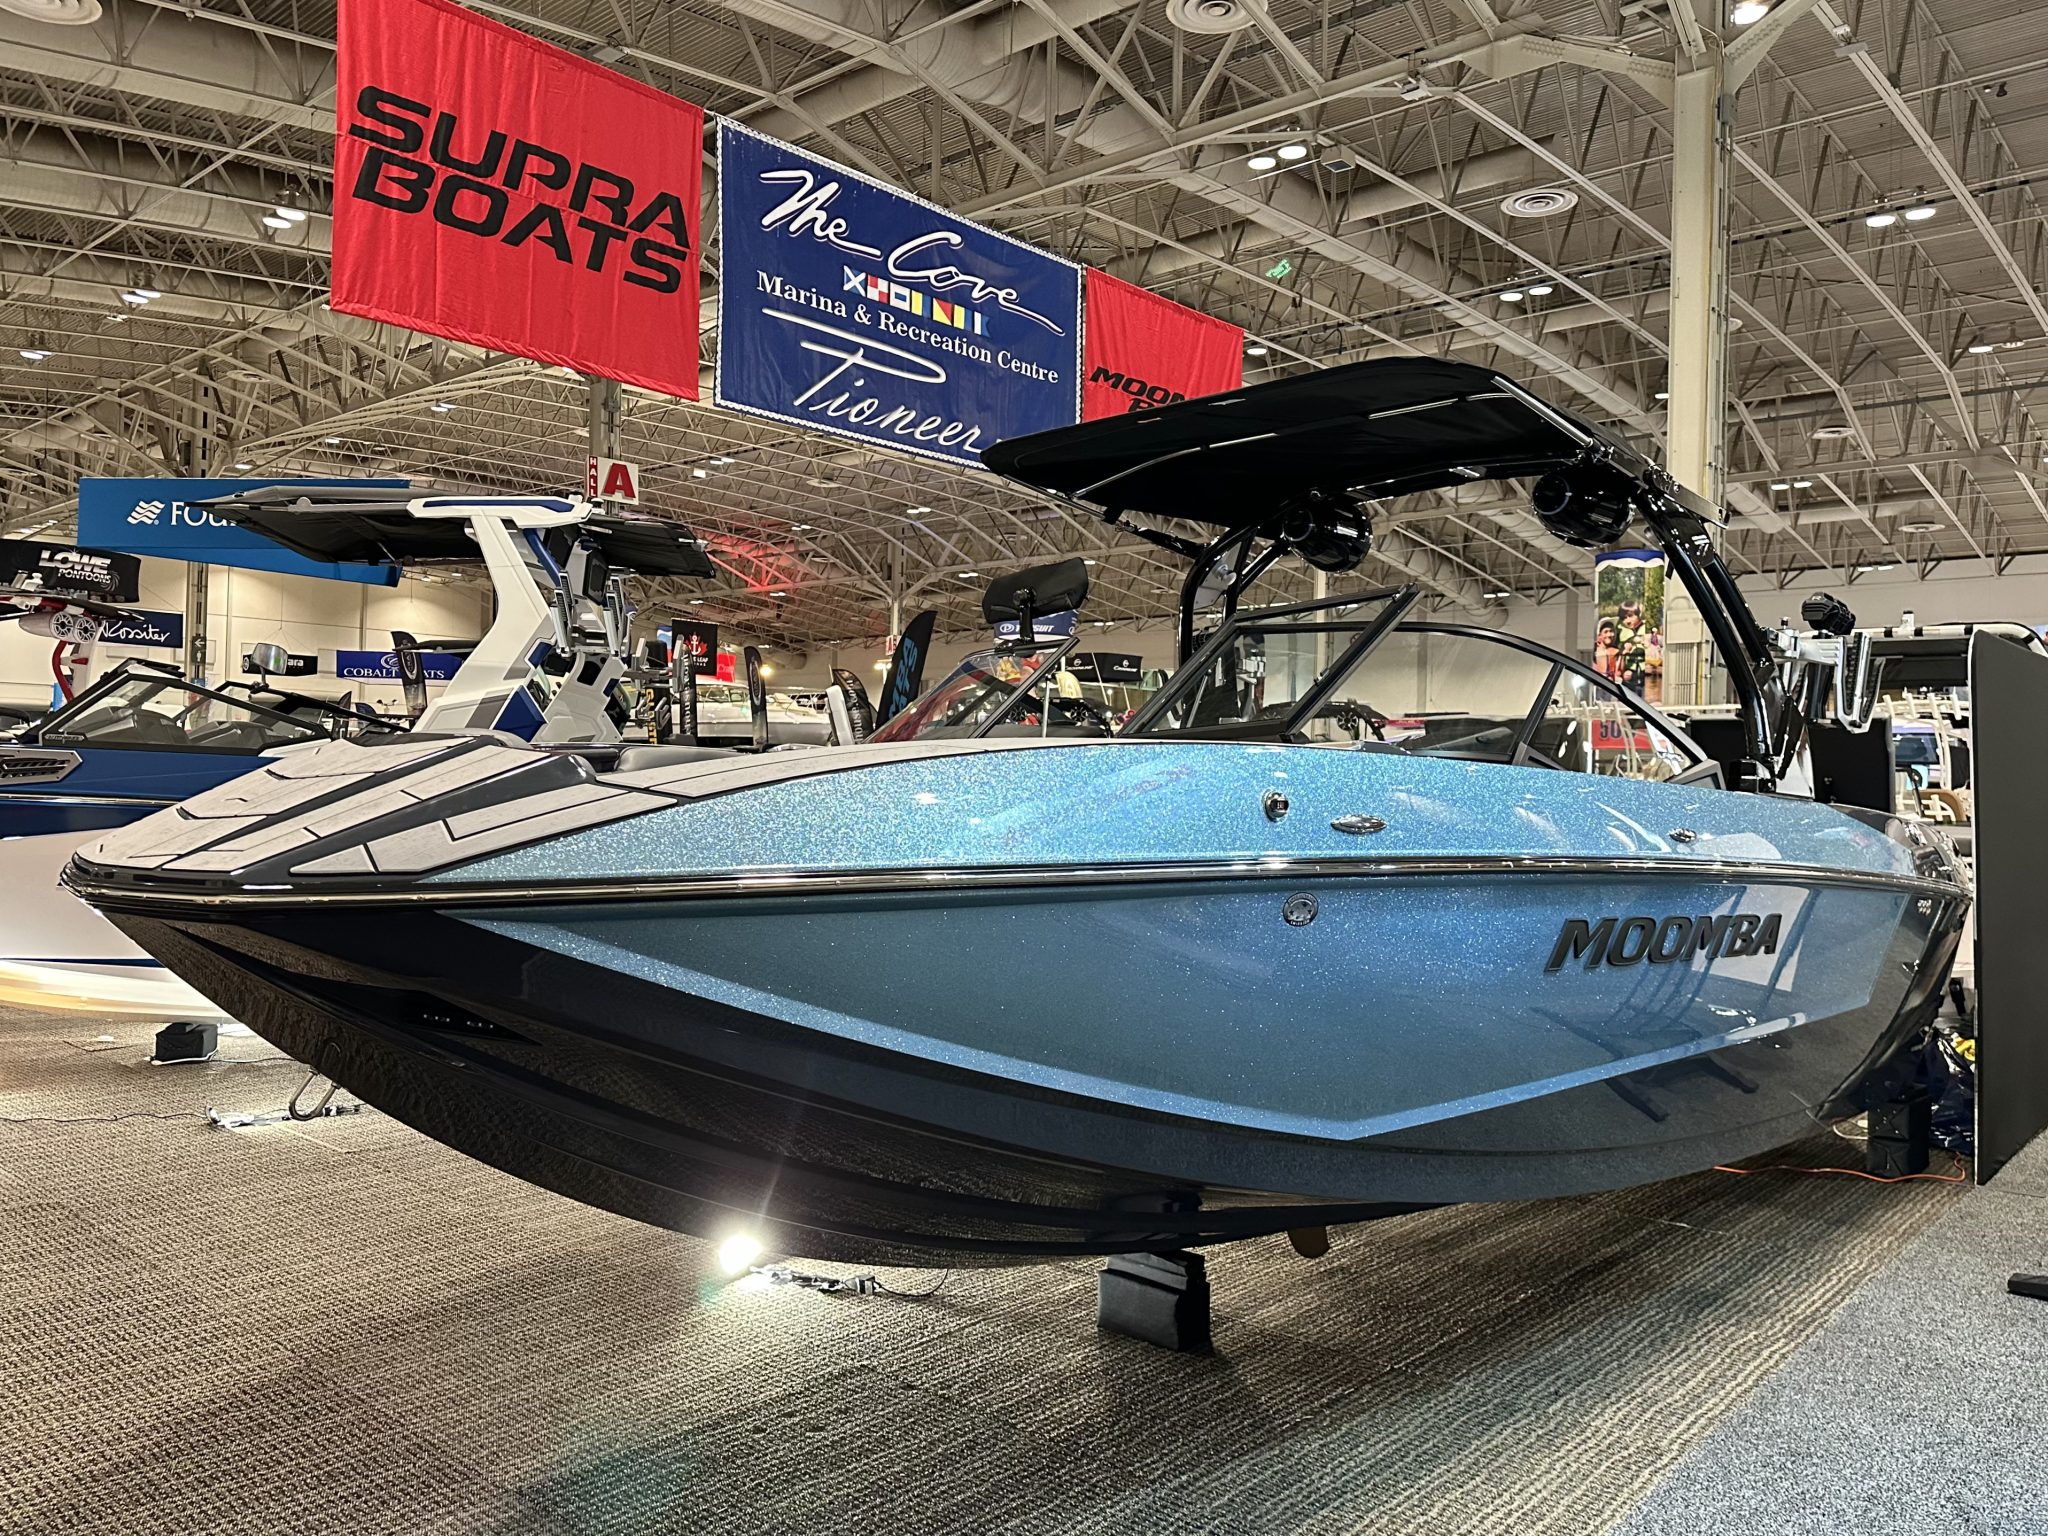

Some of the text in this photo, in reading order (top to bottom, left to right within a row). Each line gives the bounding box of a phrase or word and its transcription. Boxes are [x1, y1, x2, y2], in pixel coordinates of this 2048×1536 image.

[348, 85, 691, 249] SUPRA
[352, 145, 687, 293] BOATS
[760, 170, 1065, 334] The Cove
[757, 270, 1059, 383] Marina & Recreation Centre
[762, 308, 984, 454] Pioneer
[589, 457, 597, 497] HALL
[602, 462, 636, 499] A
[39, 550, 111, 575] LOWE
[58, 569, 112, 584] PONTOONS
[343, 667, 398, 678] COBALT
[1544, 913, 1782, 972] MOOMBA
